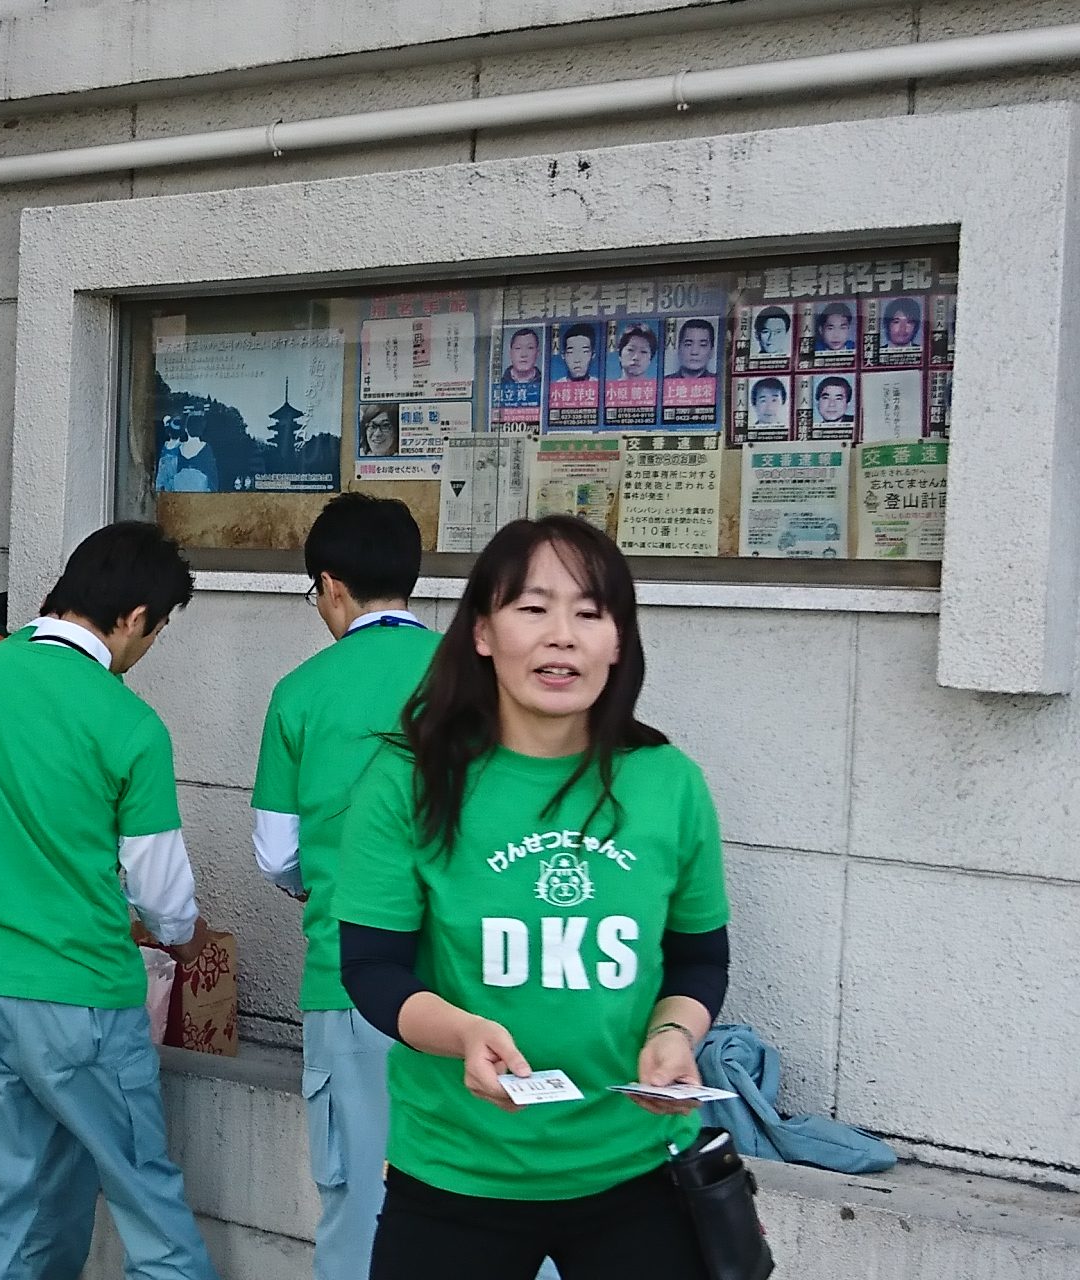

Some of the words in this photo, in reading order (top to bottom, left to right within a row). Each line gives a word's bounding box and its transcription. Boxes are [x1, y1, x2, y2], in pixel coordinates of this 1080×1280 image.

[763, 258, 932, 298] 重要指名手配
[503, 282, 655, 320] 重要指名手配
[628, 437, 717, 450] 交番速報
[864, 445, 948, 466] 交番速
[487, 830, 637, 873] けんせつにゃんこ
[482, 915, 638, 990] DKS
